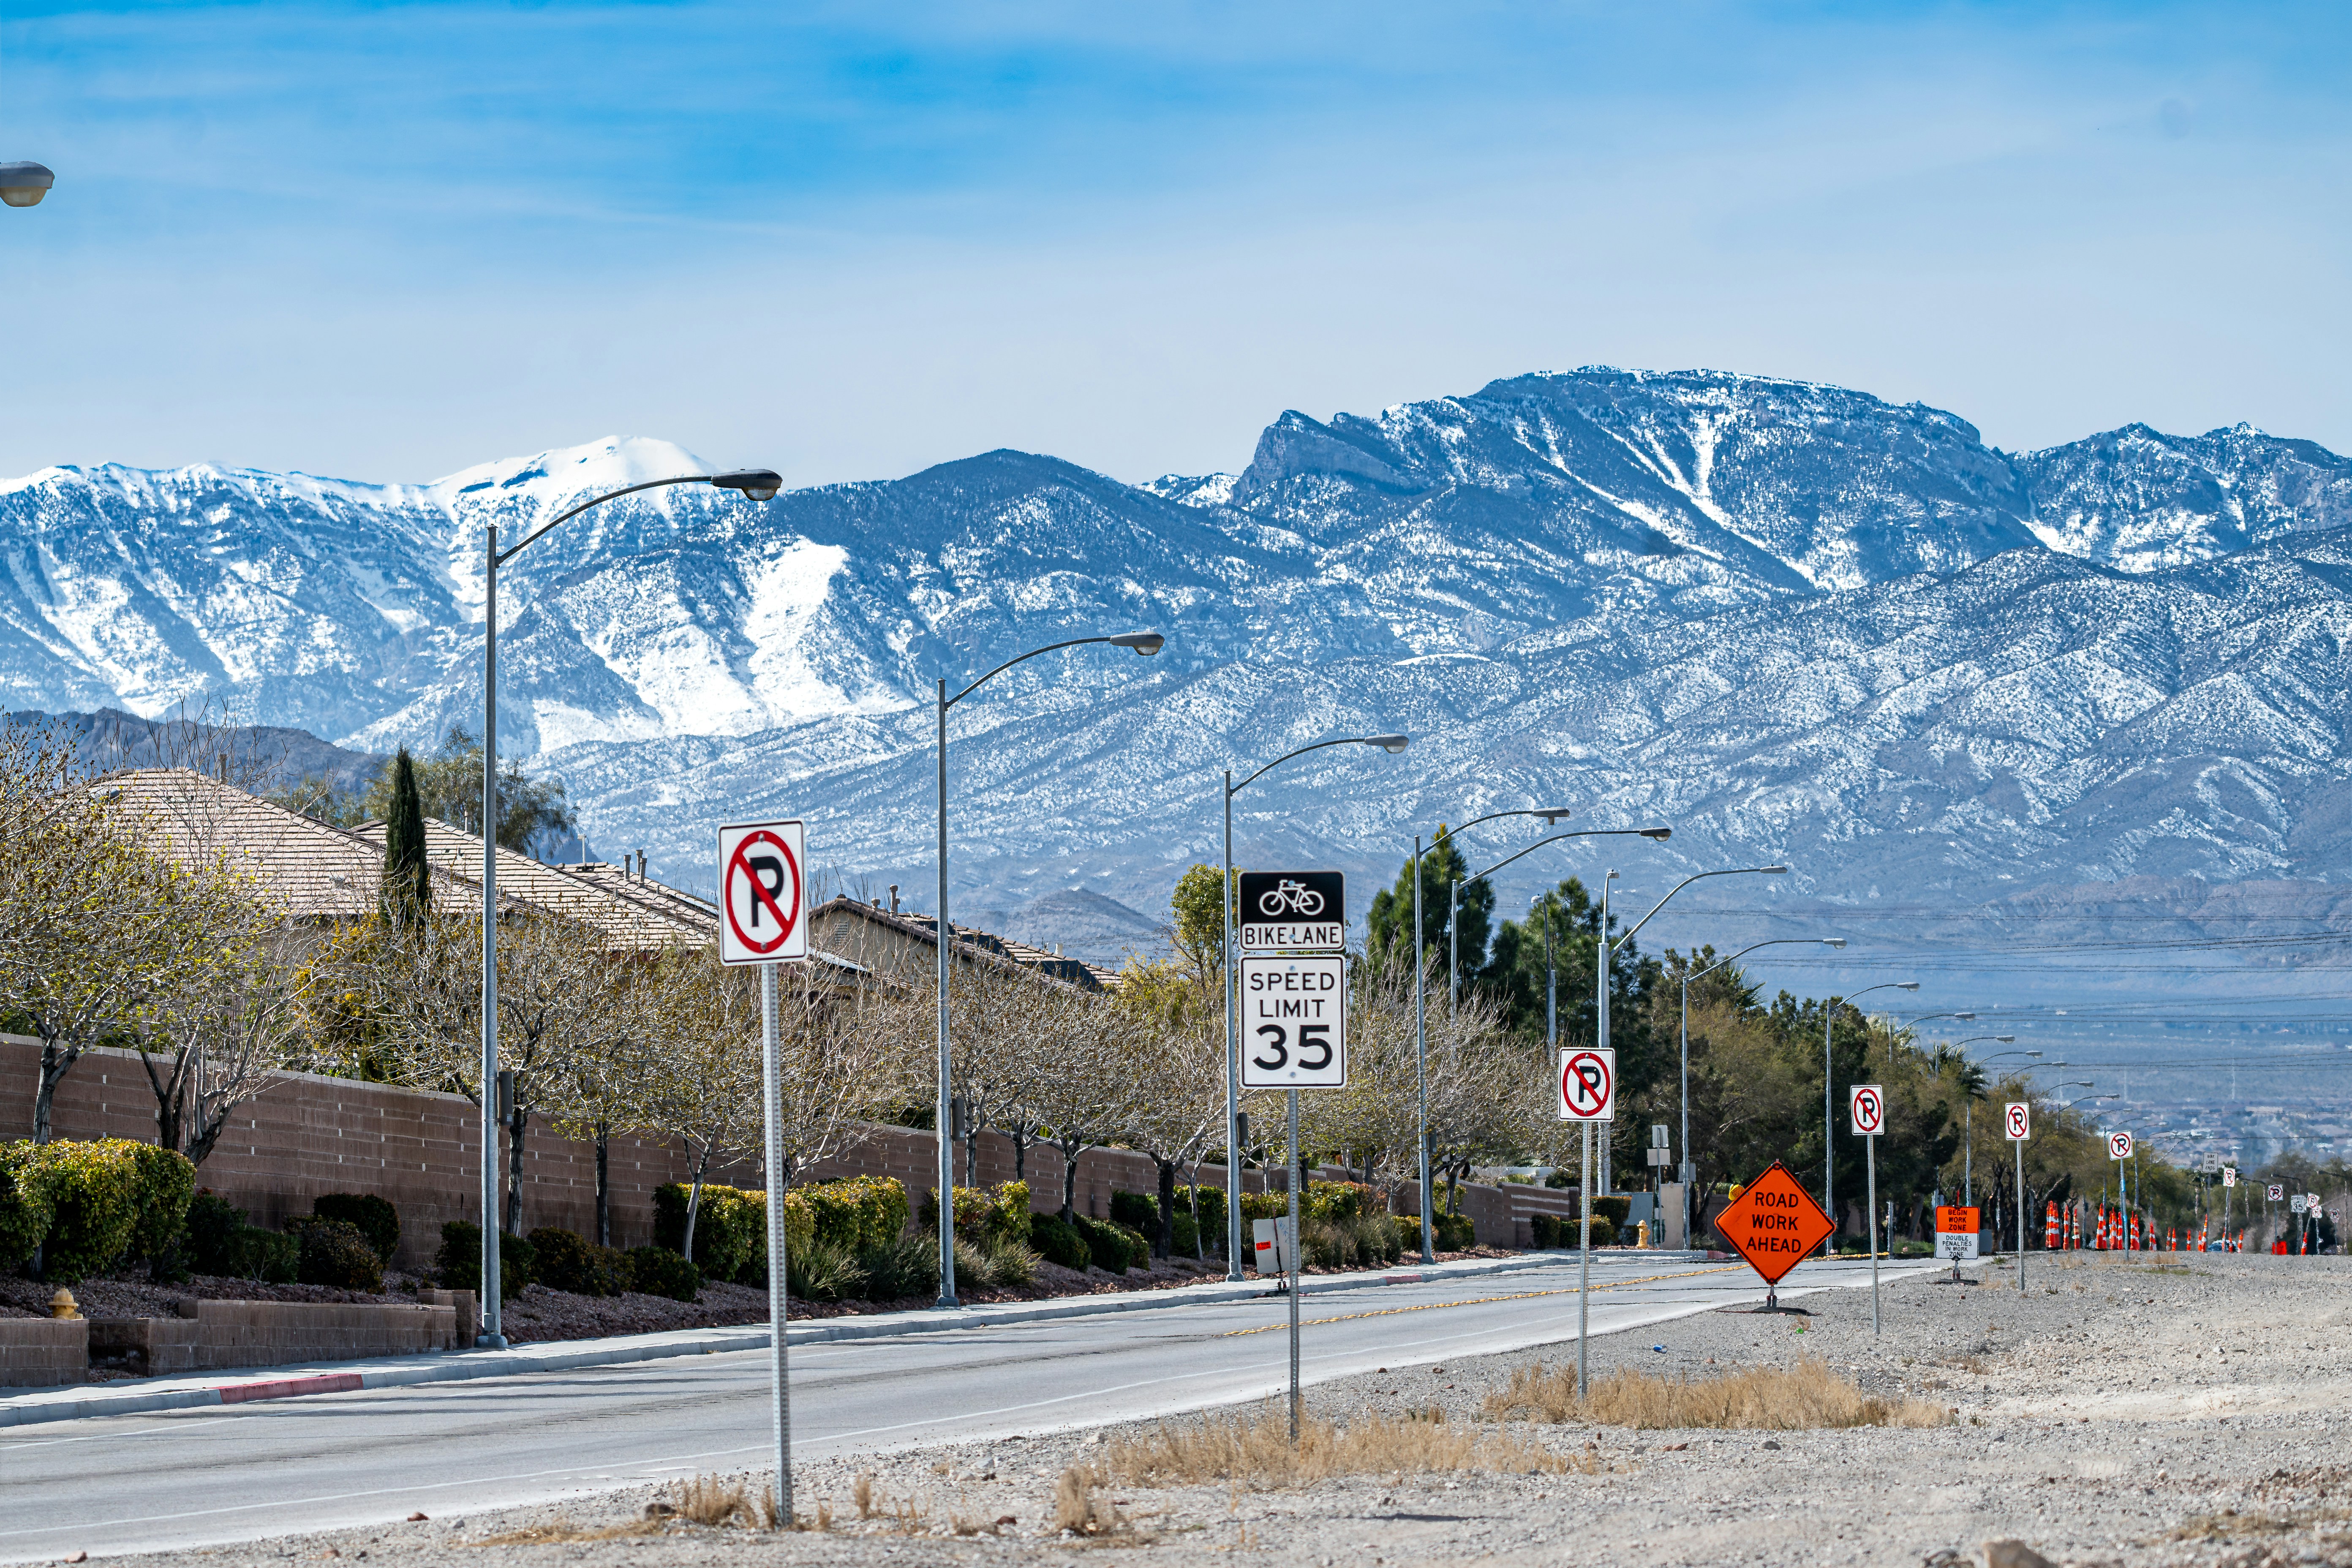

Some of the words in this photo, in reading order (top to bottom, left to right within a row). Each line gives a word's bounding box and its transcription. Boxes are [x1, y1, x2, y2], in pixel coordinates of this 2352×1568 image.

[749, 856, 784, 927] P
[1244, 927, 1287, 945] BIKE
[1292, 926, 1340, 945] LANE
[1250, 972, 1335, 991] SPEED
[1260, 999, 1326, 1018] LIMIT
[1252, 1024, 1333, 1070] 35
[1578, 1065, 1601, 1103] P
[1862, 1097, 1875, 1122] P
[2013, 1112, 2023, 1131] P
[1755, 1192, 1799, 1209] ROAD
[1752, 1214, 1799, 1231] WORK
[1745, 1236, 1802, 1254] AHEAD
